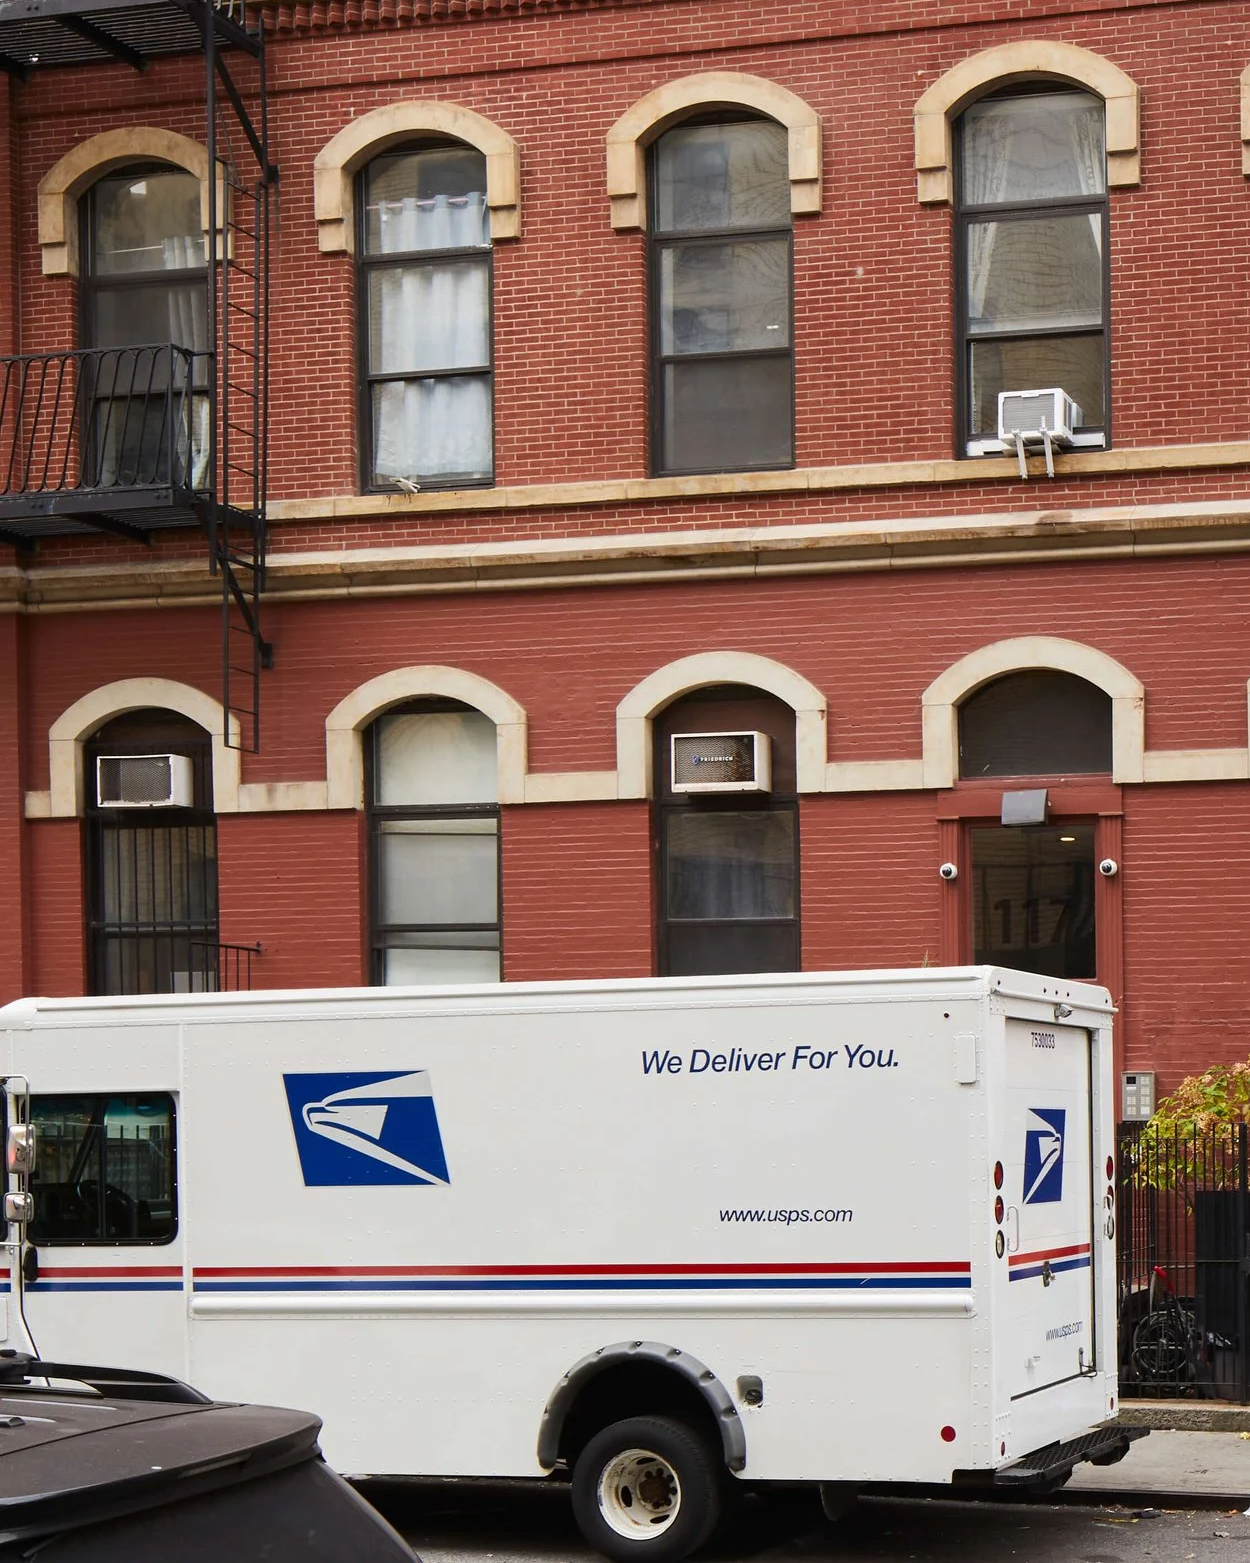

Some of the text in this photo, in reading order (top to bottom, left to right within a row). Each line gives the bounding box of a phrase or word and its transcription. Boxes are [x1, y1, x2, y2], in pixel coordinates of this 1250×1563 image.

[993, 899, 1071, 944] 117
[641, 1043, 899, 1075] We Deliver For You.
[719, 1208, 853, 1226] www.usps.com
